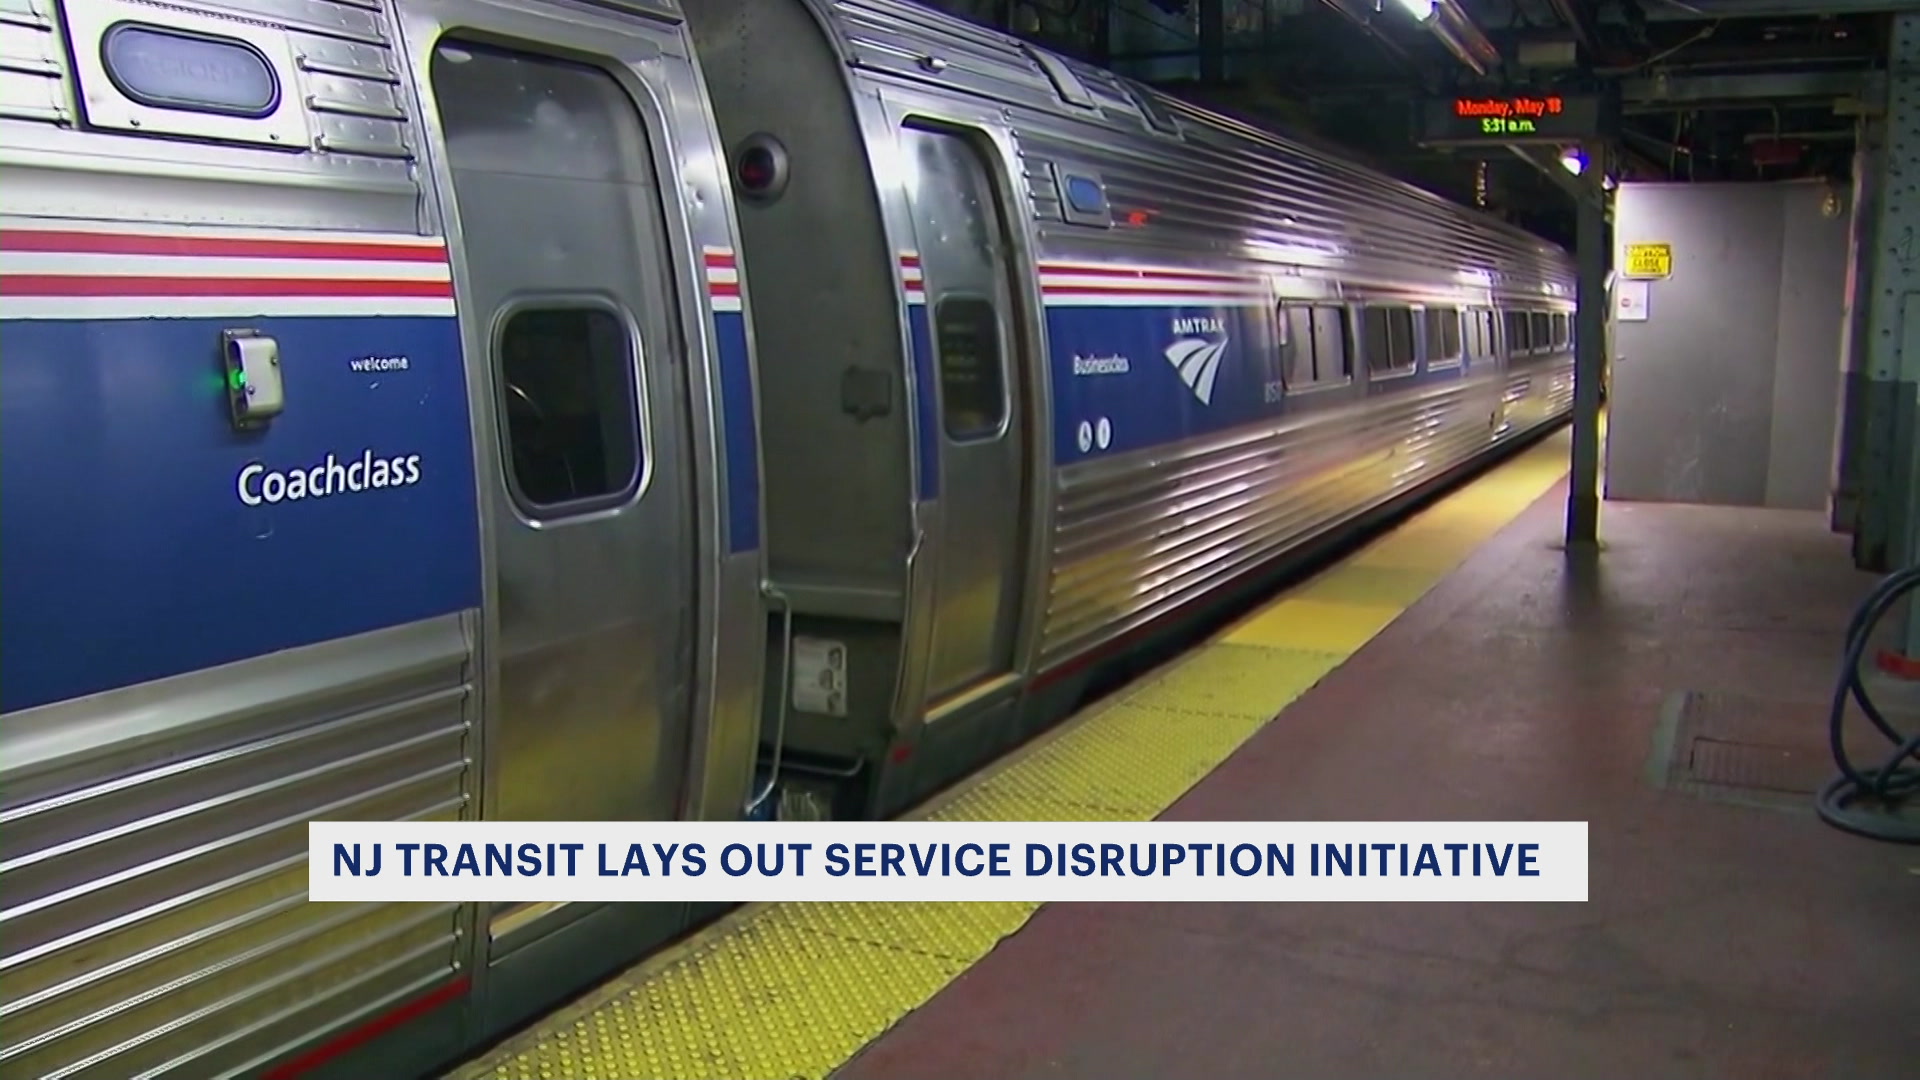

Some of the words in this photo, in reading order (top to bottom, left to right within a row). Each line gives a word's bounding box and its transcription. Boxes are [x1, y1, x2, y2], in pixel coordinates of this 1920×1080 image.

[1458, 99, 1513, 117] Monday,
[1515, 99, 1545, 117] May
[1482, 117, 1506, 133] 5:31
[1508, 120, 1536, 132] a.m.
[1173, 318, 1225, 334] AMTRAK
[351, 357, 409, 372] welcome
[238, 449, 421, 506] Coachclass
